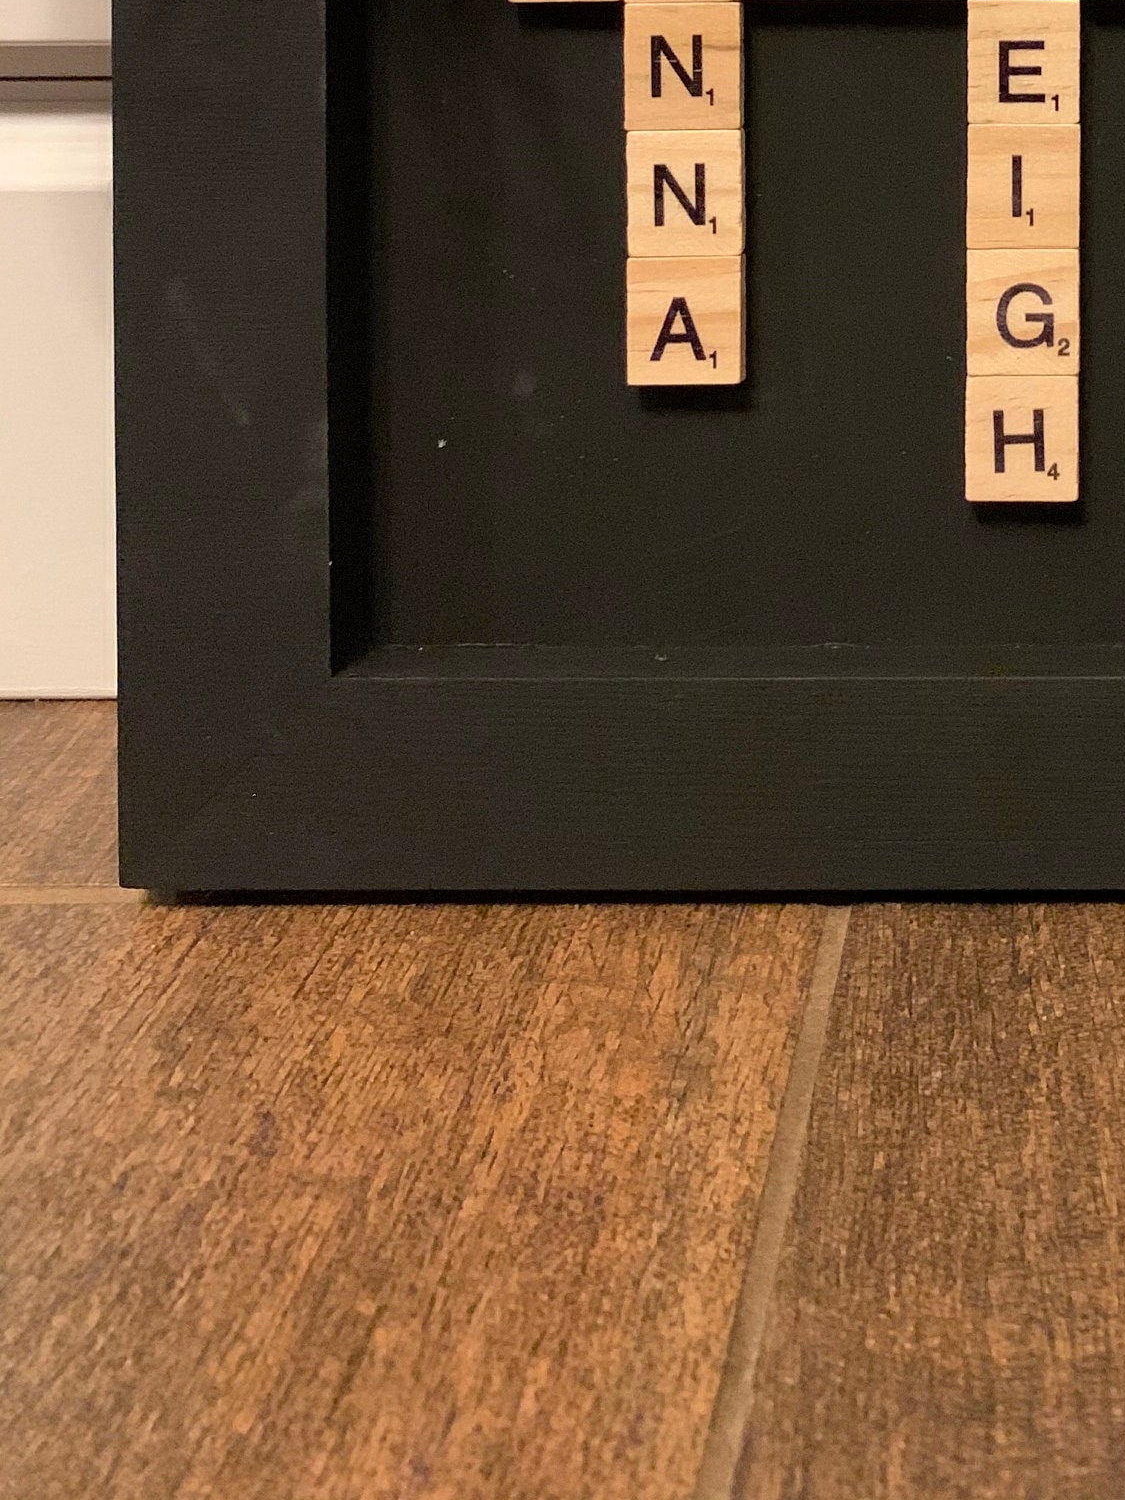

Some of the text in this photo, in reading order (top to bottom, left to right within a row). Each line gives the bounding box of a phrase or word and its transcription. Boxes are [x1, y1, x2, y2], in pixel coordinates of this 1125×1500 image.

[704, 88, 715, 107] 1
[1050, 94, 1061, 112] 1
[707, 216, 718, 235] 1
[1024, 208, 1035, 227] 1
[1056, 338, 1071, 357] 2
[708, 350, 718, 369] 1
[1045, 462, 1061, 481] 4
